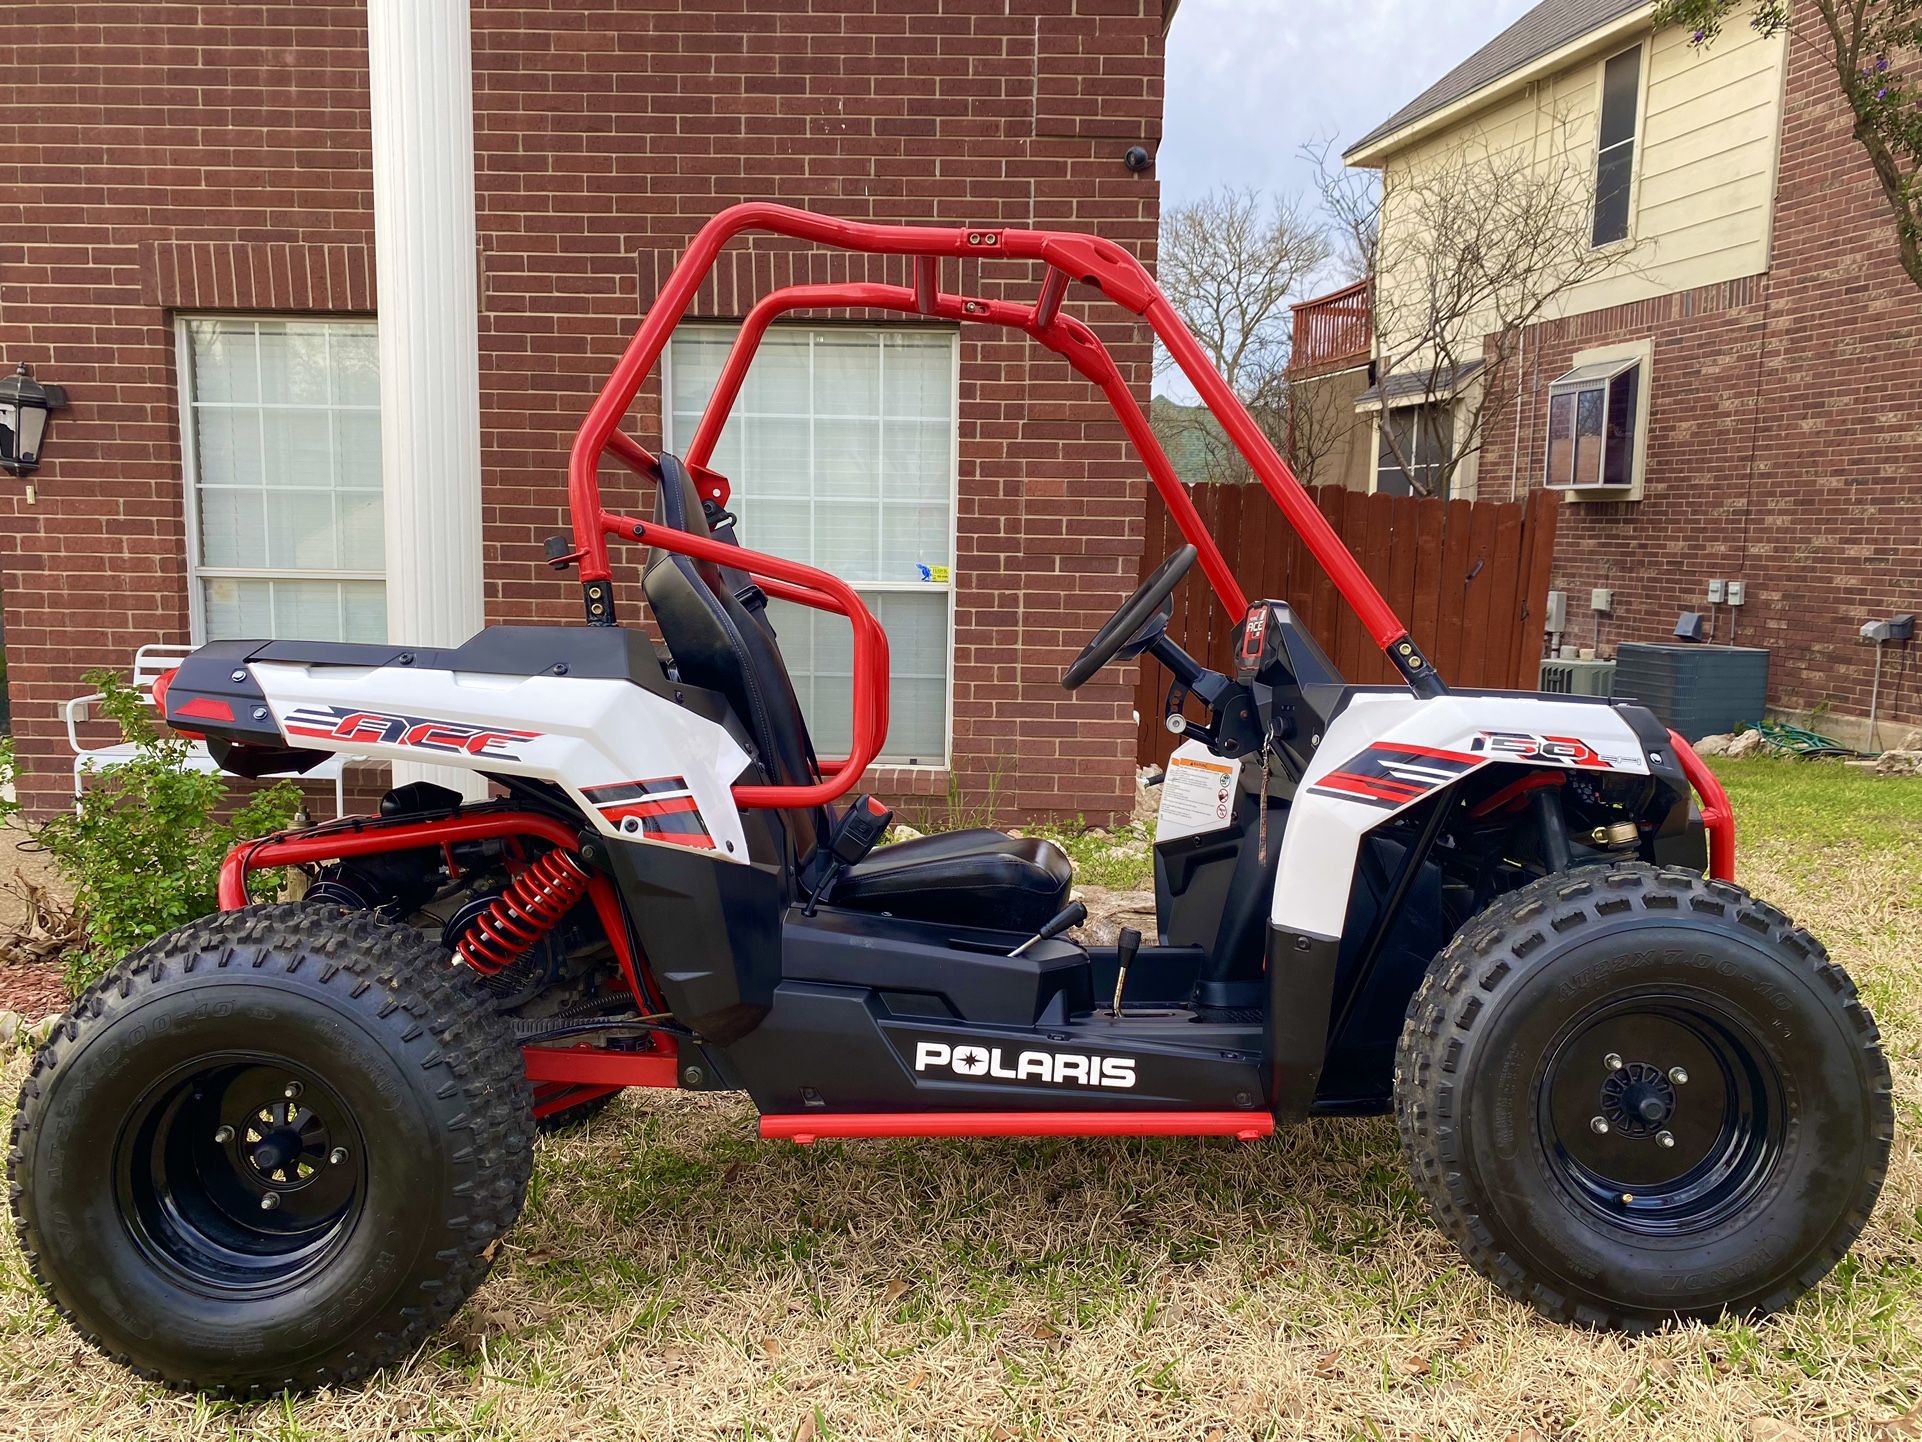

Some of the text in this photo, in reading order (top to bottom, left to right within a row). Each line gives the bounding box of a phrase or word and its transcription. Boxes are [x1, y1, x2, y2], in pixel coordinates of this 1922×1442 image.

[1246, 620, 1265, 633] ACE
[330, 711, 546, 763] ACE
[1471, 733, 1590, 762] 150
[915, 1041, 1136, 1088] POLARIS
